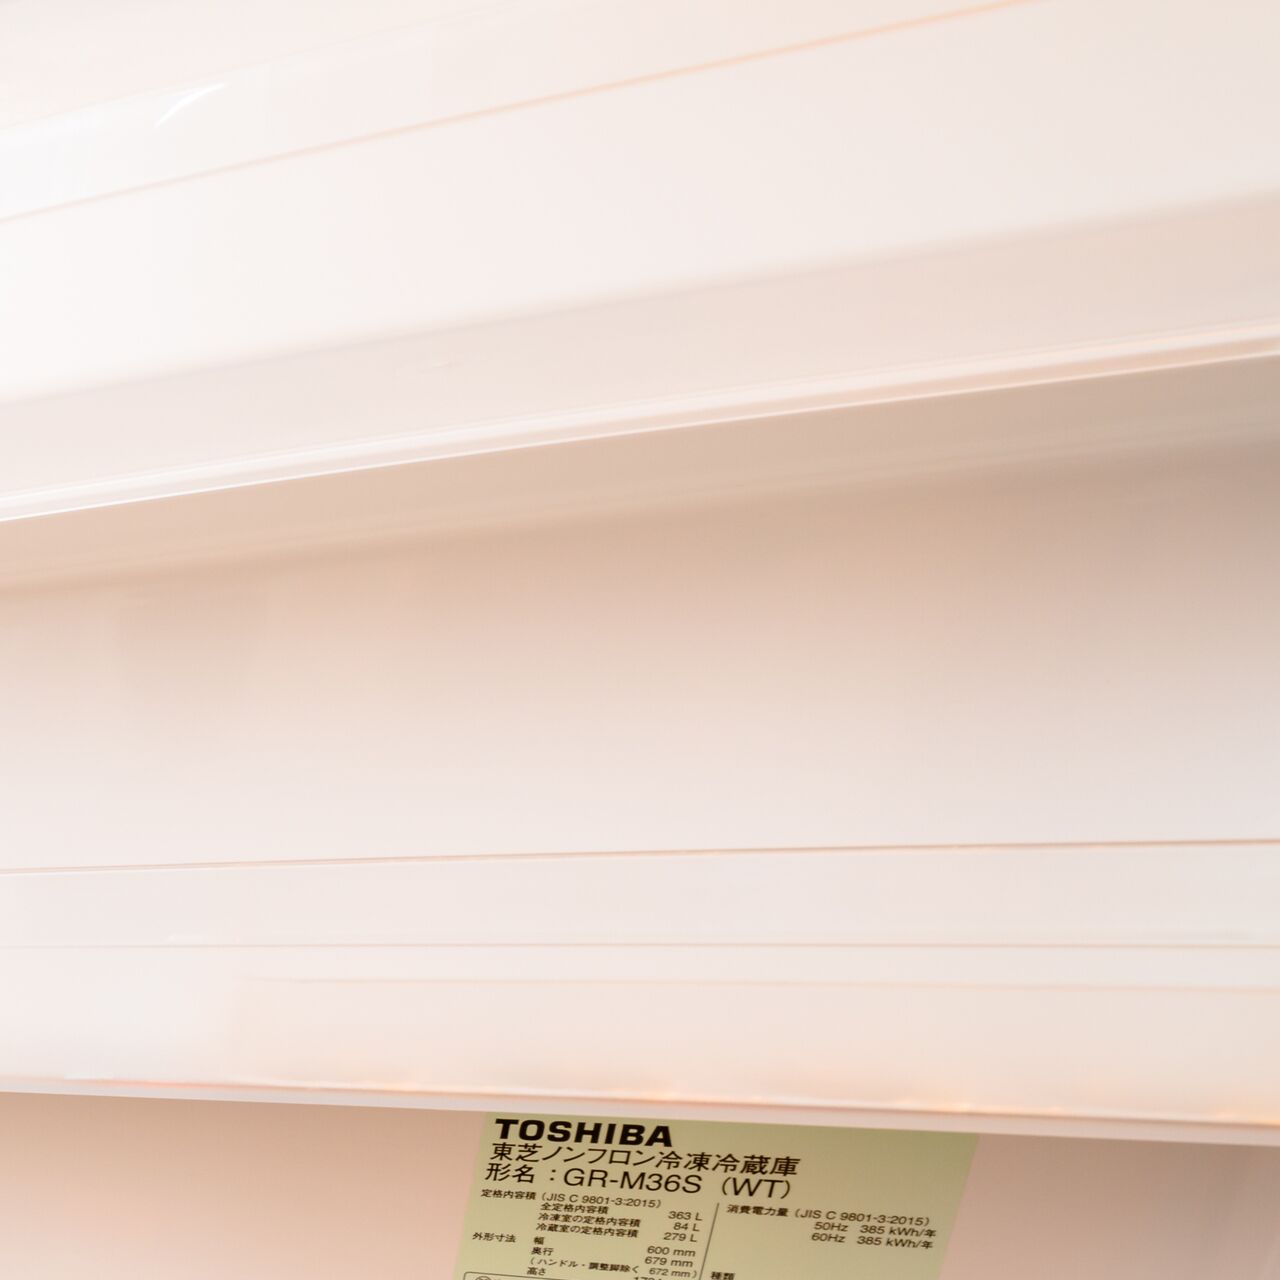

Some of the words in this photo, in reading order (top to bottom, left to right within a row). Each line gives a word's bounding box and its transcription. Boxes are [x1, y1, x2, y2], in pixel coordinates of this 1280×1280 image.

[495, 1118, 673, 1148] TOSHIBA
[490, 1142, 801, 1177] 東芝ノンフロン冷凍冷蔵庫
[563, 1168, 703, 1194] GR-M36S
[722, 1177, 791, 1200] (WT)
[569, 1194, 579, 1203] C
[668, 1211, 691, 1221] 363
[695, 1212, 702, 1221] L
[727, 1204, 789, 1218] 消費電力量
[826, 1210, 837, 1220] C
[674, 1222, 688, 1231] 84
[692, 1223, 700, 1232] L
[813, 1221, 848, 1233] 50Hz
[860, 1224, 885, 1235] 385
[663, 1232, 686, 1242] 279
[690, 1234, 697, 1242] L
[811, 1232, 845, 1243] 60Hz
[857, 1235, 882, 1246] 385
[647, 1246, 670, 1255] 600
[673, 1249, 696, 1257] mm
[645, 1256, 667, 1265] 679
[670, 1259, 693, 1268] mm
[649, 1267, 668, 1276] 672
